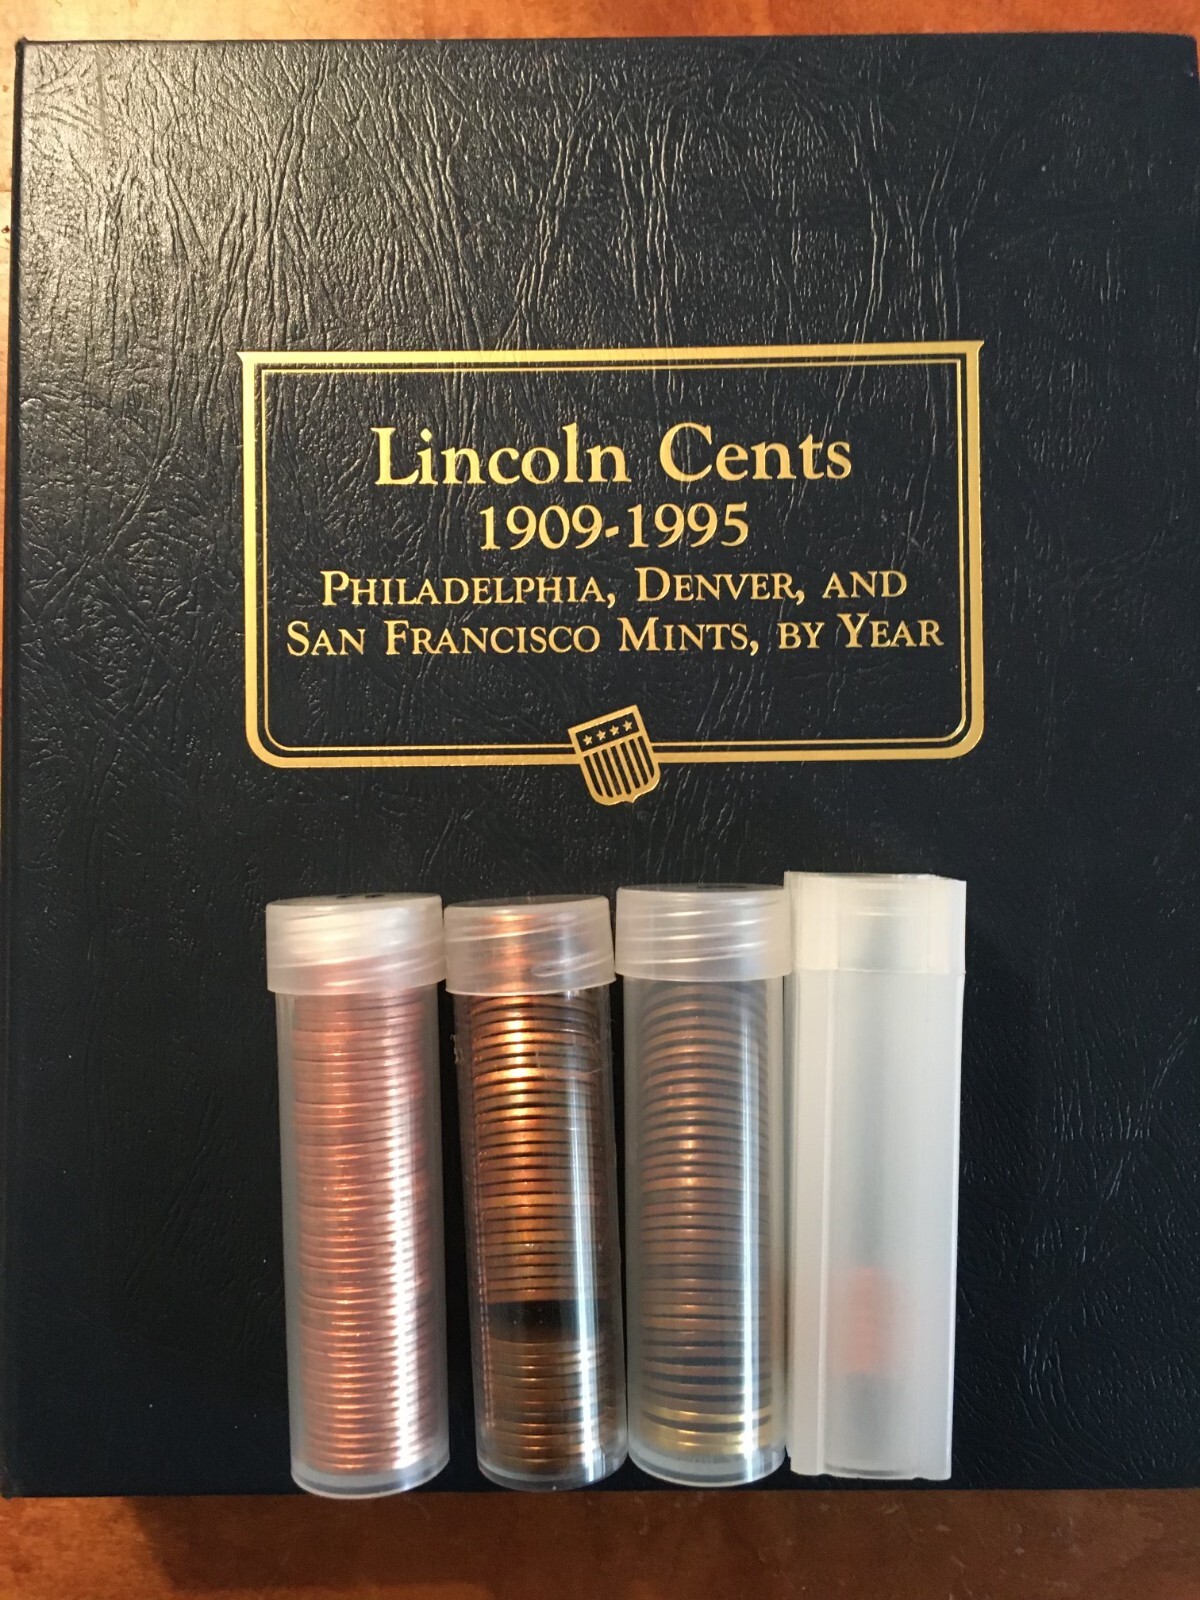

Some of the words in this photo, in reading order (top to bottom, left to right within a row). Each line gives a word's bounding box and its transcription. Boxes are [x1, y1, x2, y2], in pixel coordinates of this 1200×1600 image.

[370, 420, 631, 488] Lincoln
[659, 421, 852, 484] Cents
[479, 501, 749, 551] 1909-1995
[319, 570, 616, 608] PHILADELPHIA,
[635, 566, 805, 606] DENVER,
[822, 569, 908, 600] AND
[286, 620, 366, 657] SAN
[383, 618, 601, 656] FRANCISCO
[617, 616, 760, 656] MINTS,
[777, 621, 825, 651] BY
[837, 612, 943, 650] YEAR
